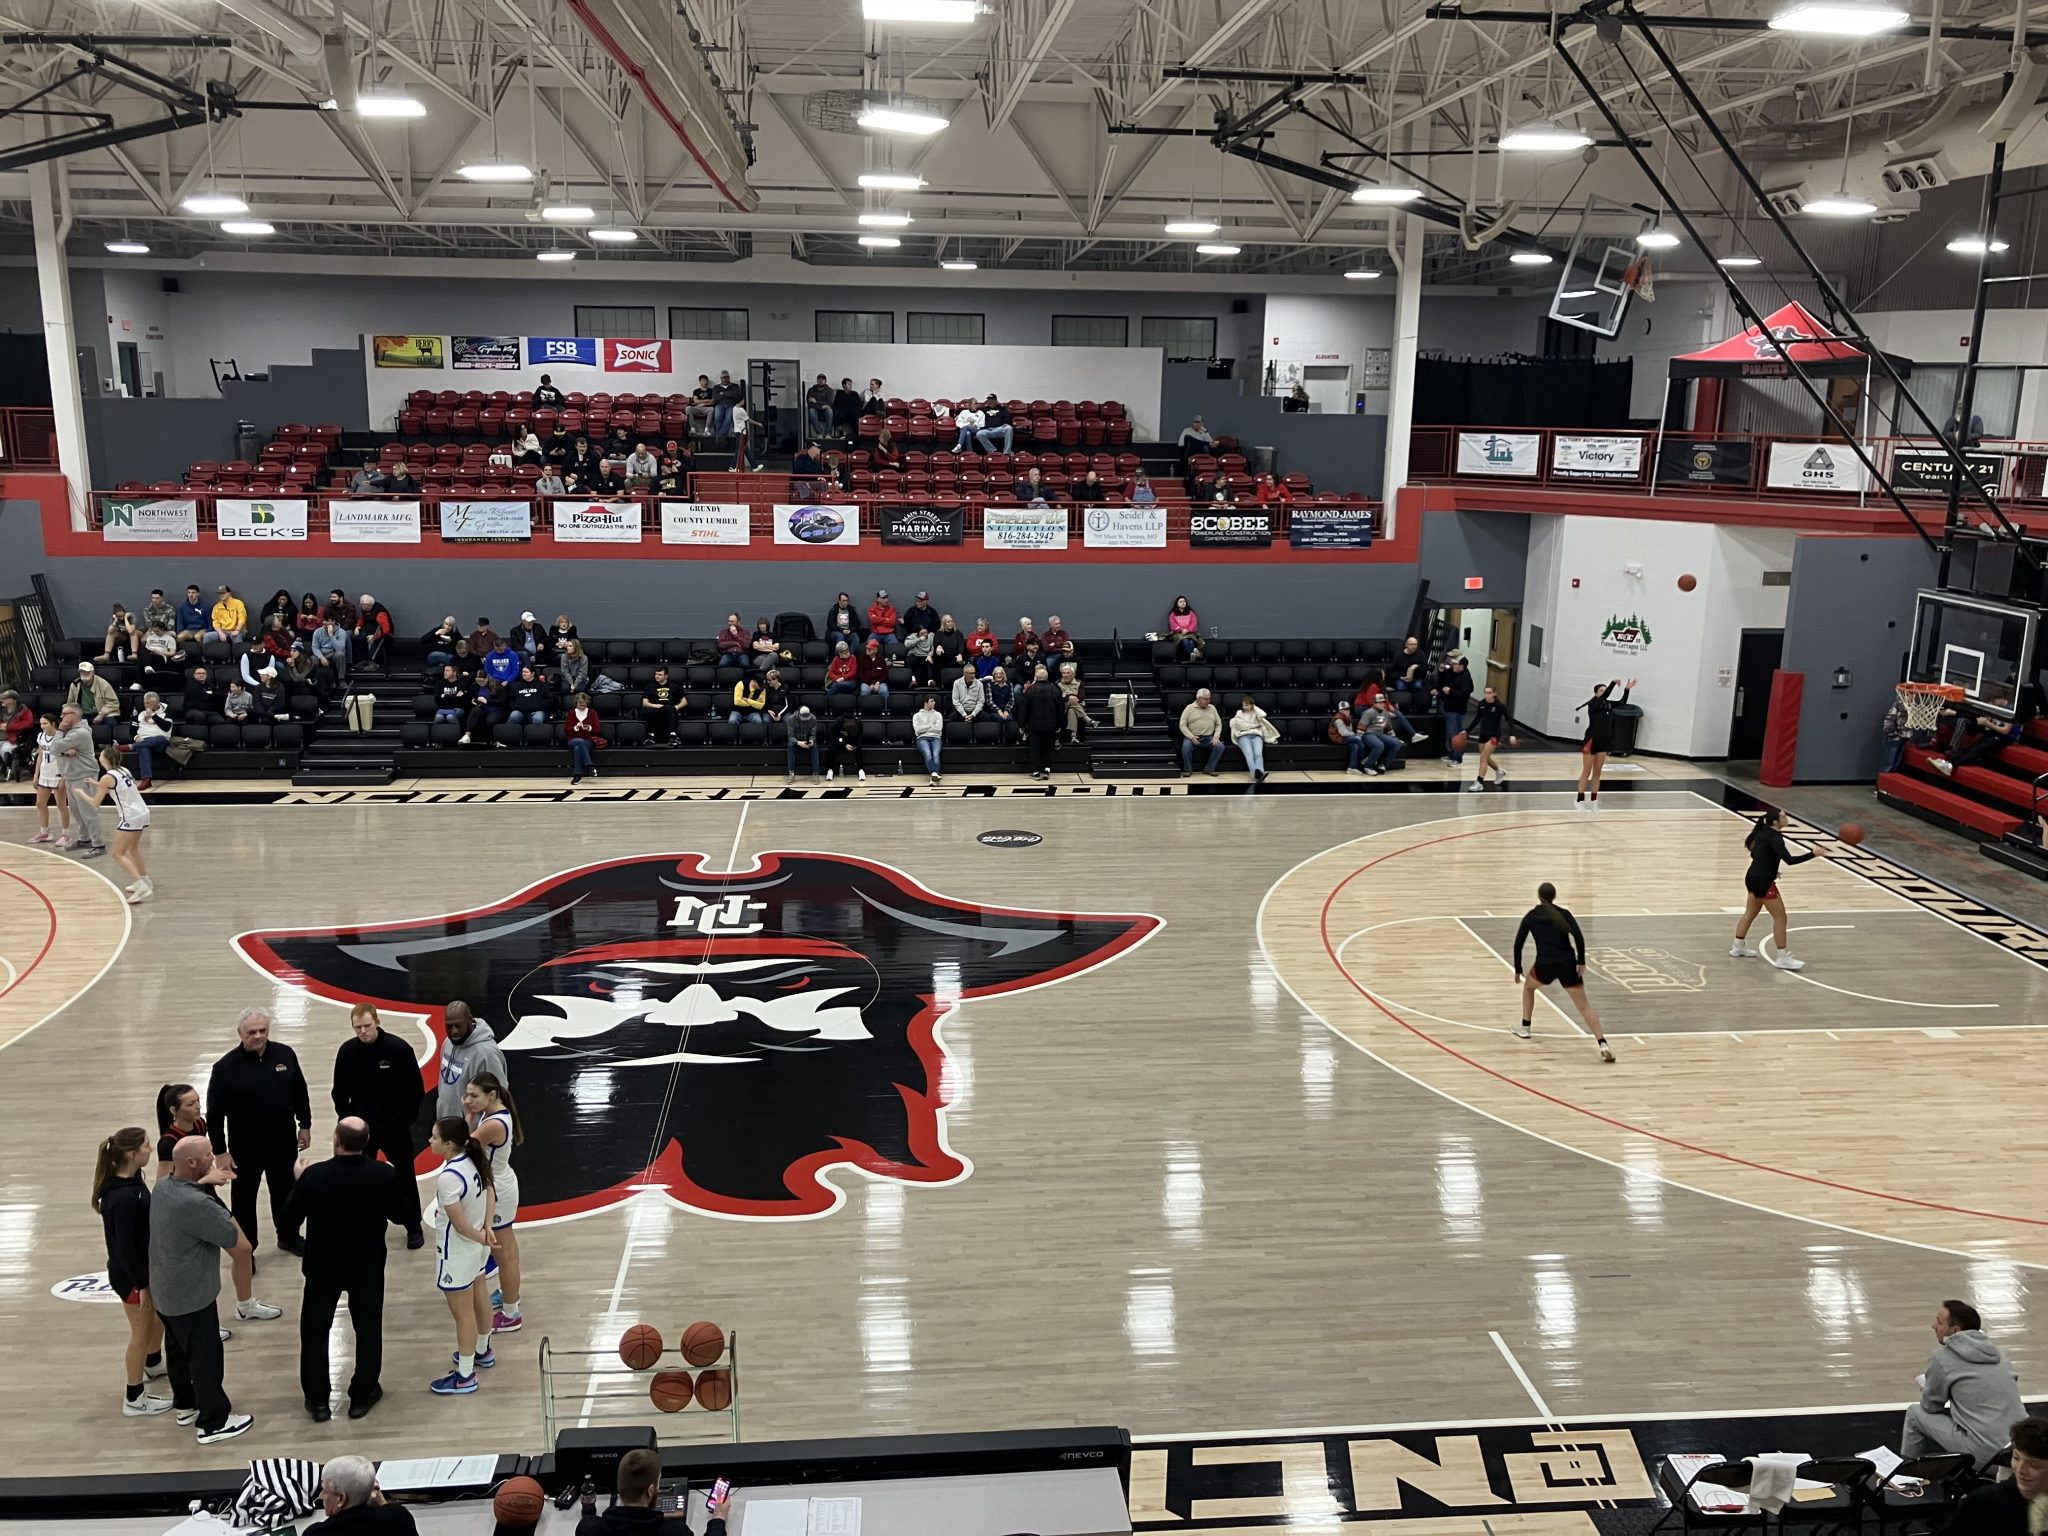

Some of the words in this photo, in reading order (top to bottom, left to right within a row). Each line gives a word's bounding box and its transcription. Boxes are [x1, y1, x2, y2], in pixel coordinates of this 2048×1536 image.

[416, 339, 434, 347] BERRY
[546, 341, 577, 356] FSB
[620, 350, 655, 360] SONIC
[1579, 451, 1614, 462] Victory
[1901, 462, 1974, 473] CENTUY
[1979, 465, 1994, 473] 21
[1802, 470, 1834, 478] GHS
[138, 509, 188, 517] NORTHWEST
[339, 513, 388, 521] LANDMARK
[391, 513, 413, 521] MFG.
[902, 511, 918, 522] MAIN
[919, 510, 941, 523] STREET
[1119, 511, 1144, 519] Seidel
[1149, 511, 1158, 519] &
[1291, 510, 1340, 519] RAYMOND
[1340, 510, 1372, 519] JAMES
[572, 513, 602, 523] Pizza
[602, 515, 622, 523] Hut
[1113, 522, 1143, 530] Havens
[1145, 522, 1163, 530] LLP
[1191, 516, 1269, 531] SCOBEE
[221, 528, 305, 537] BECK'S
[892, 524, 951, 533] PHARMACY
[997, 531, 1054, 540] 816-284-2942
[272, 784, 1189, 804] NCMCPIRATES.COM
[1067, 1451, 1104, 1459] NEVCO
